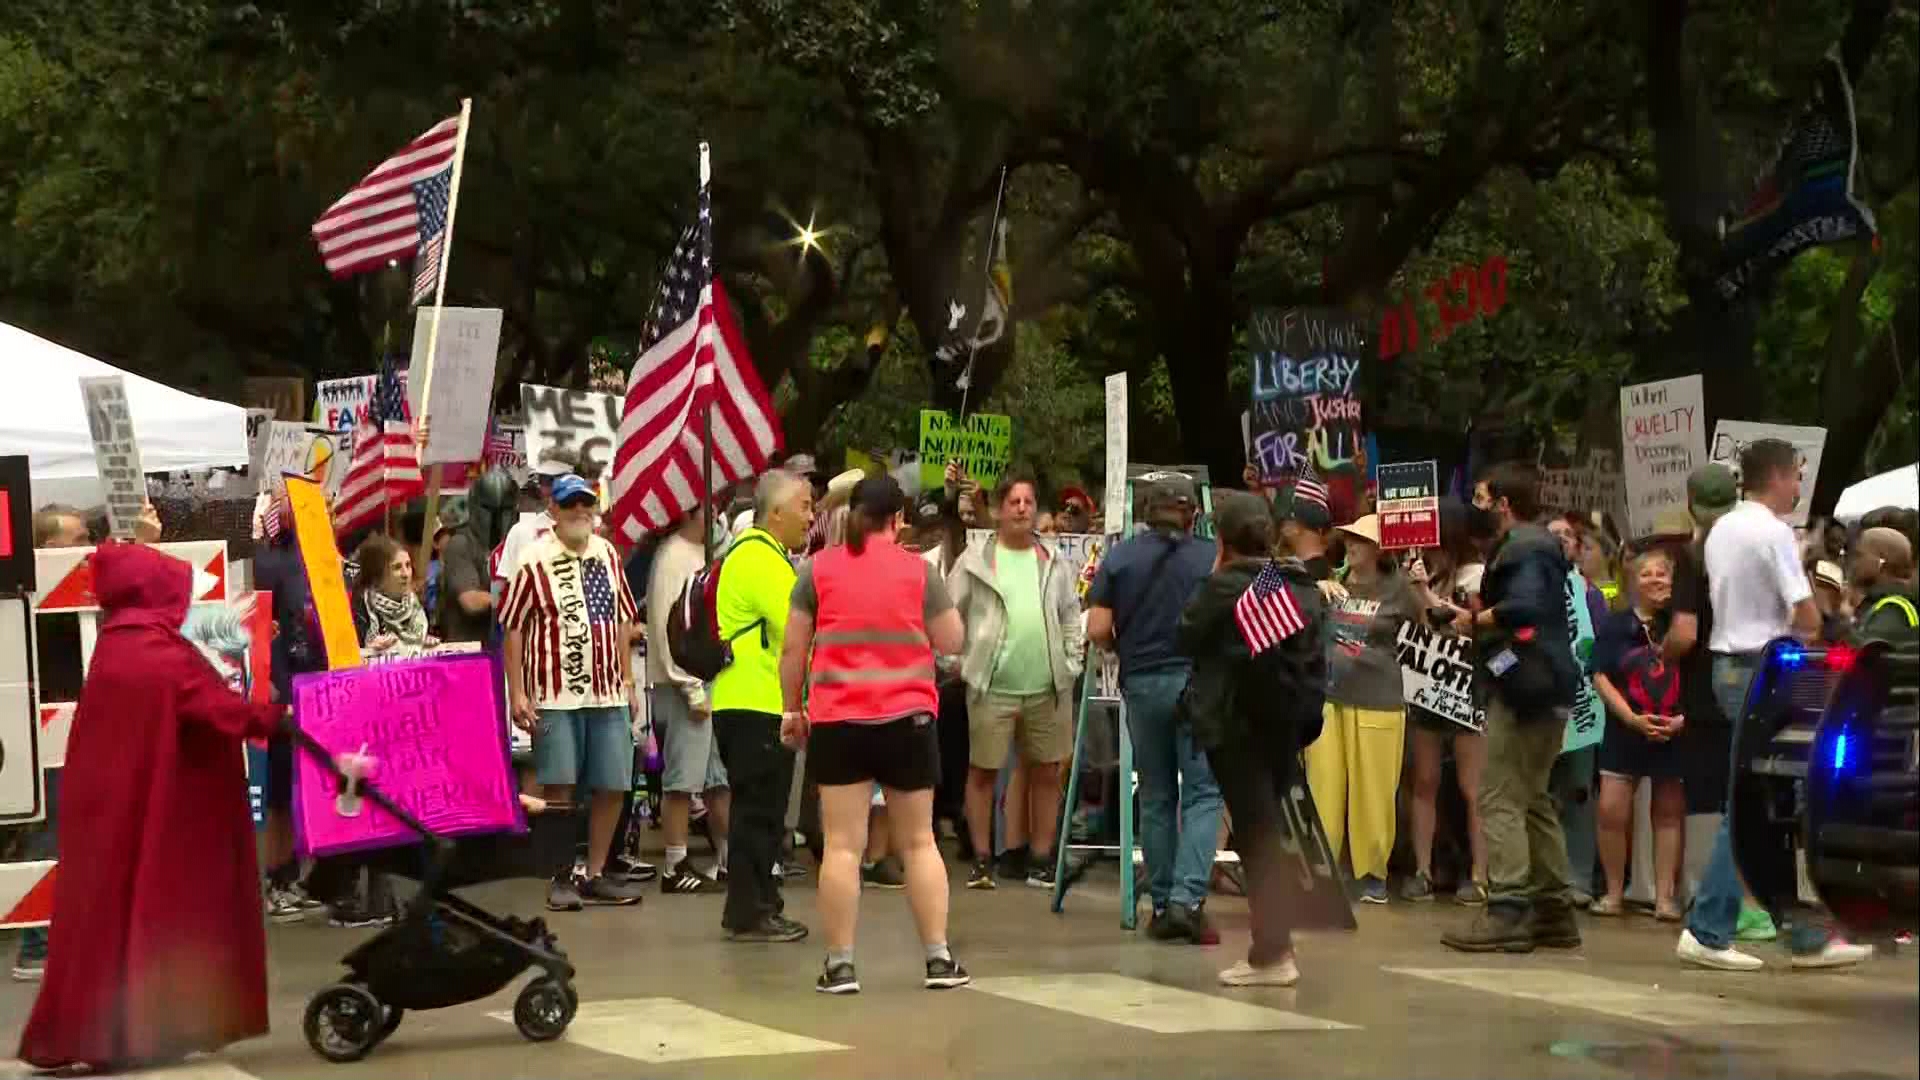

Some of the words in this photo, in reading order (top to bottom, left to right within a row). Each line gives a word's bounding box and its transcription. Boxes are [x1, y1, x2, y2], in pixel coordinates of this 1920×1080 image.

[1254, 350, 1360, 396] LIBERTY
[1624, 406, 1696, 441] CRUELTY
[1254, 430, 1307, 474] FOR
